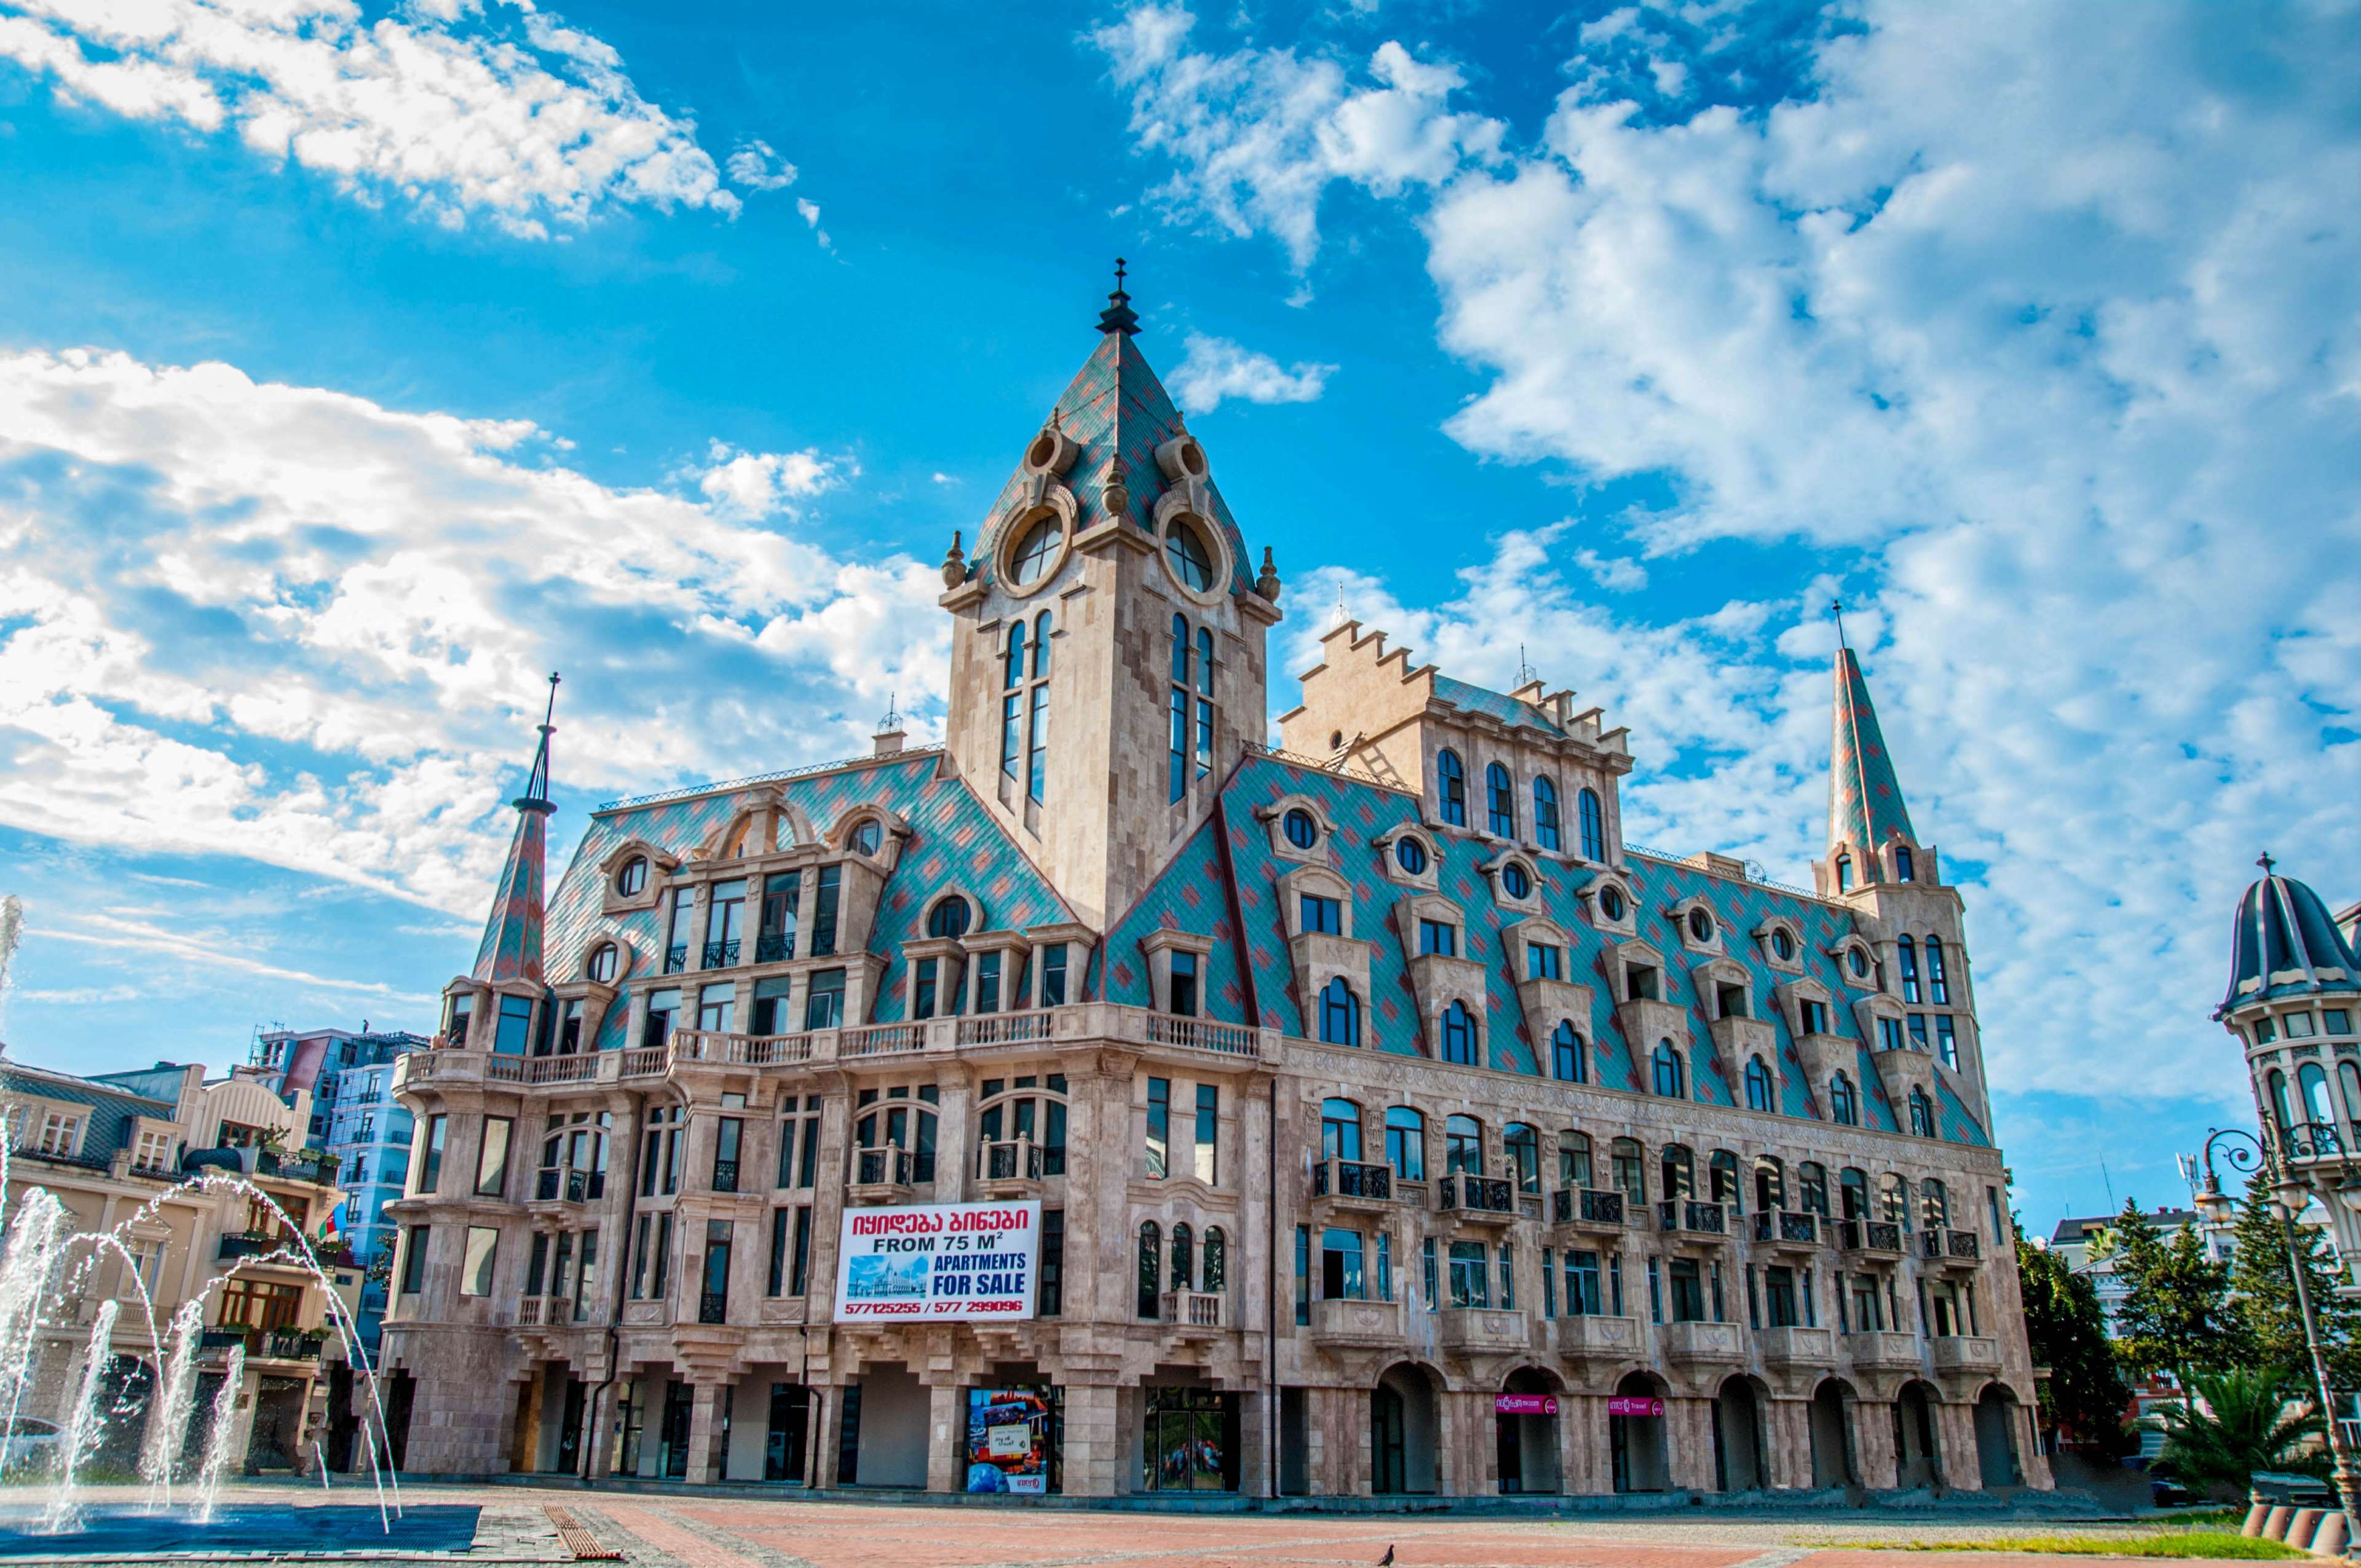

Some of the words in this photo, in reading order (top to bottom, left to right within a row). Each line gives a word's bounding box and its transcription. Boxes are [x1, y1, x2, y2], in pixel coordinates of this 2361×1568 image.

[852, 1213, 943, 1235] იყიდება
[949, 1209, 1029, 1232] ბინები
[873, 1236, 935, 1253] FROM
[943, 1235, 969, 1250] 75
[934, 1253, 1026, 1271] APARTMENTS
[933, 1274, 971, 1296] FOR
[976, 1273, 1026, 1295] SALE
[845, 1302, 921, 1314] 577125255
[934, 1301, 962, 1313] 577
[966, 1300, 1023, 1312] 299096
